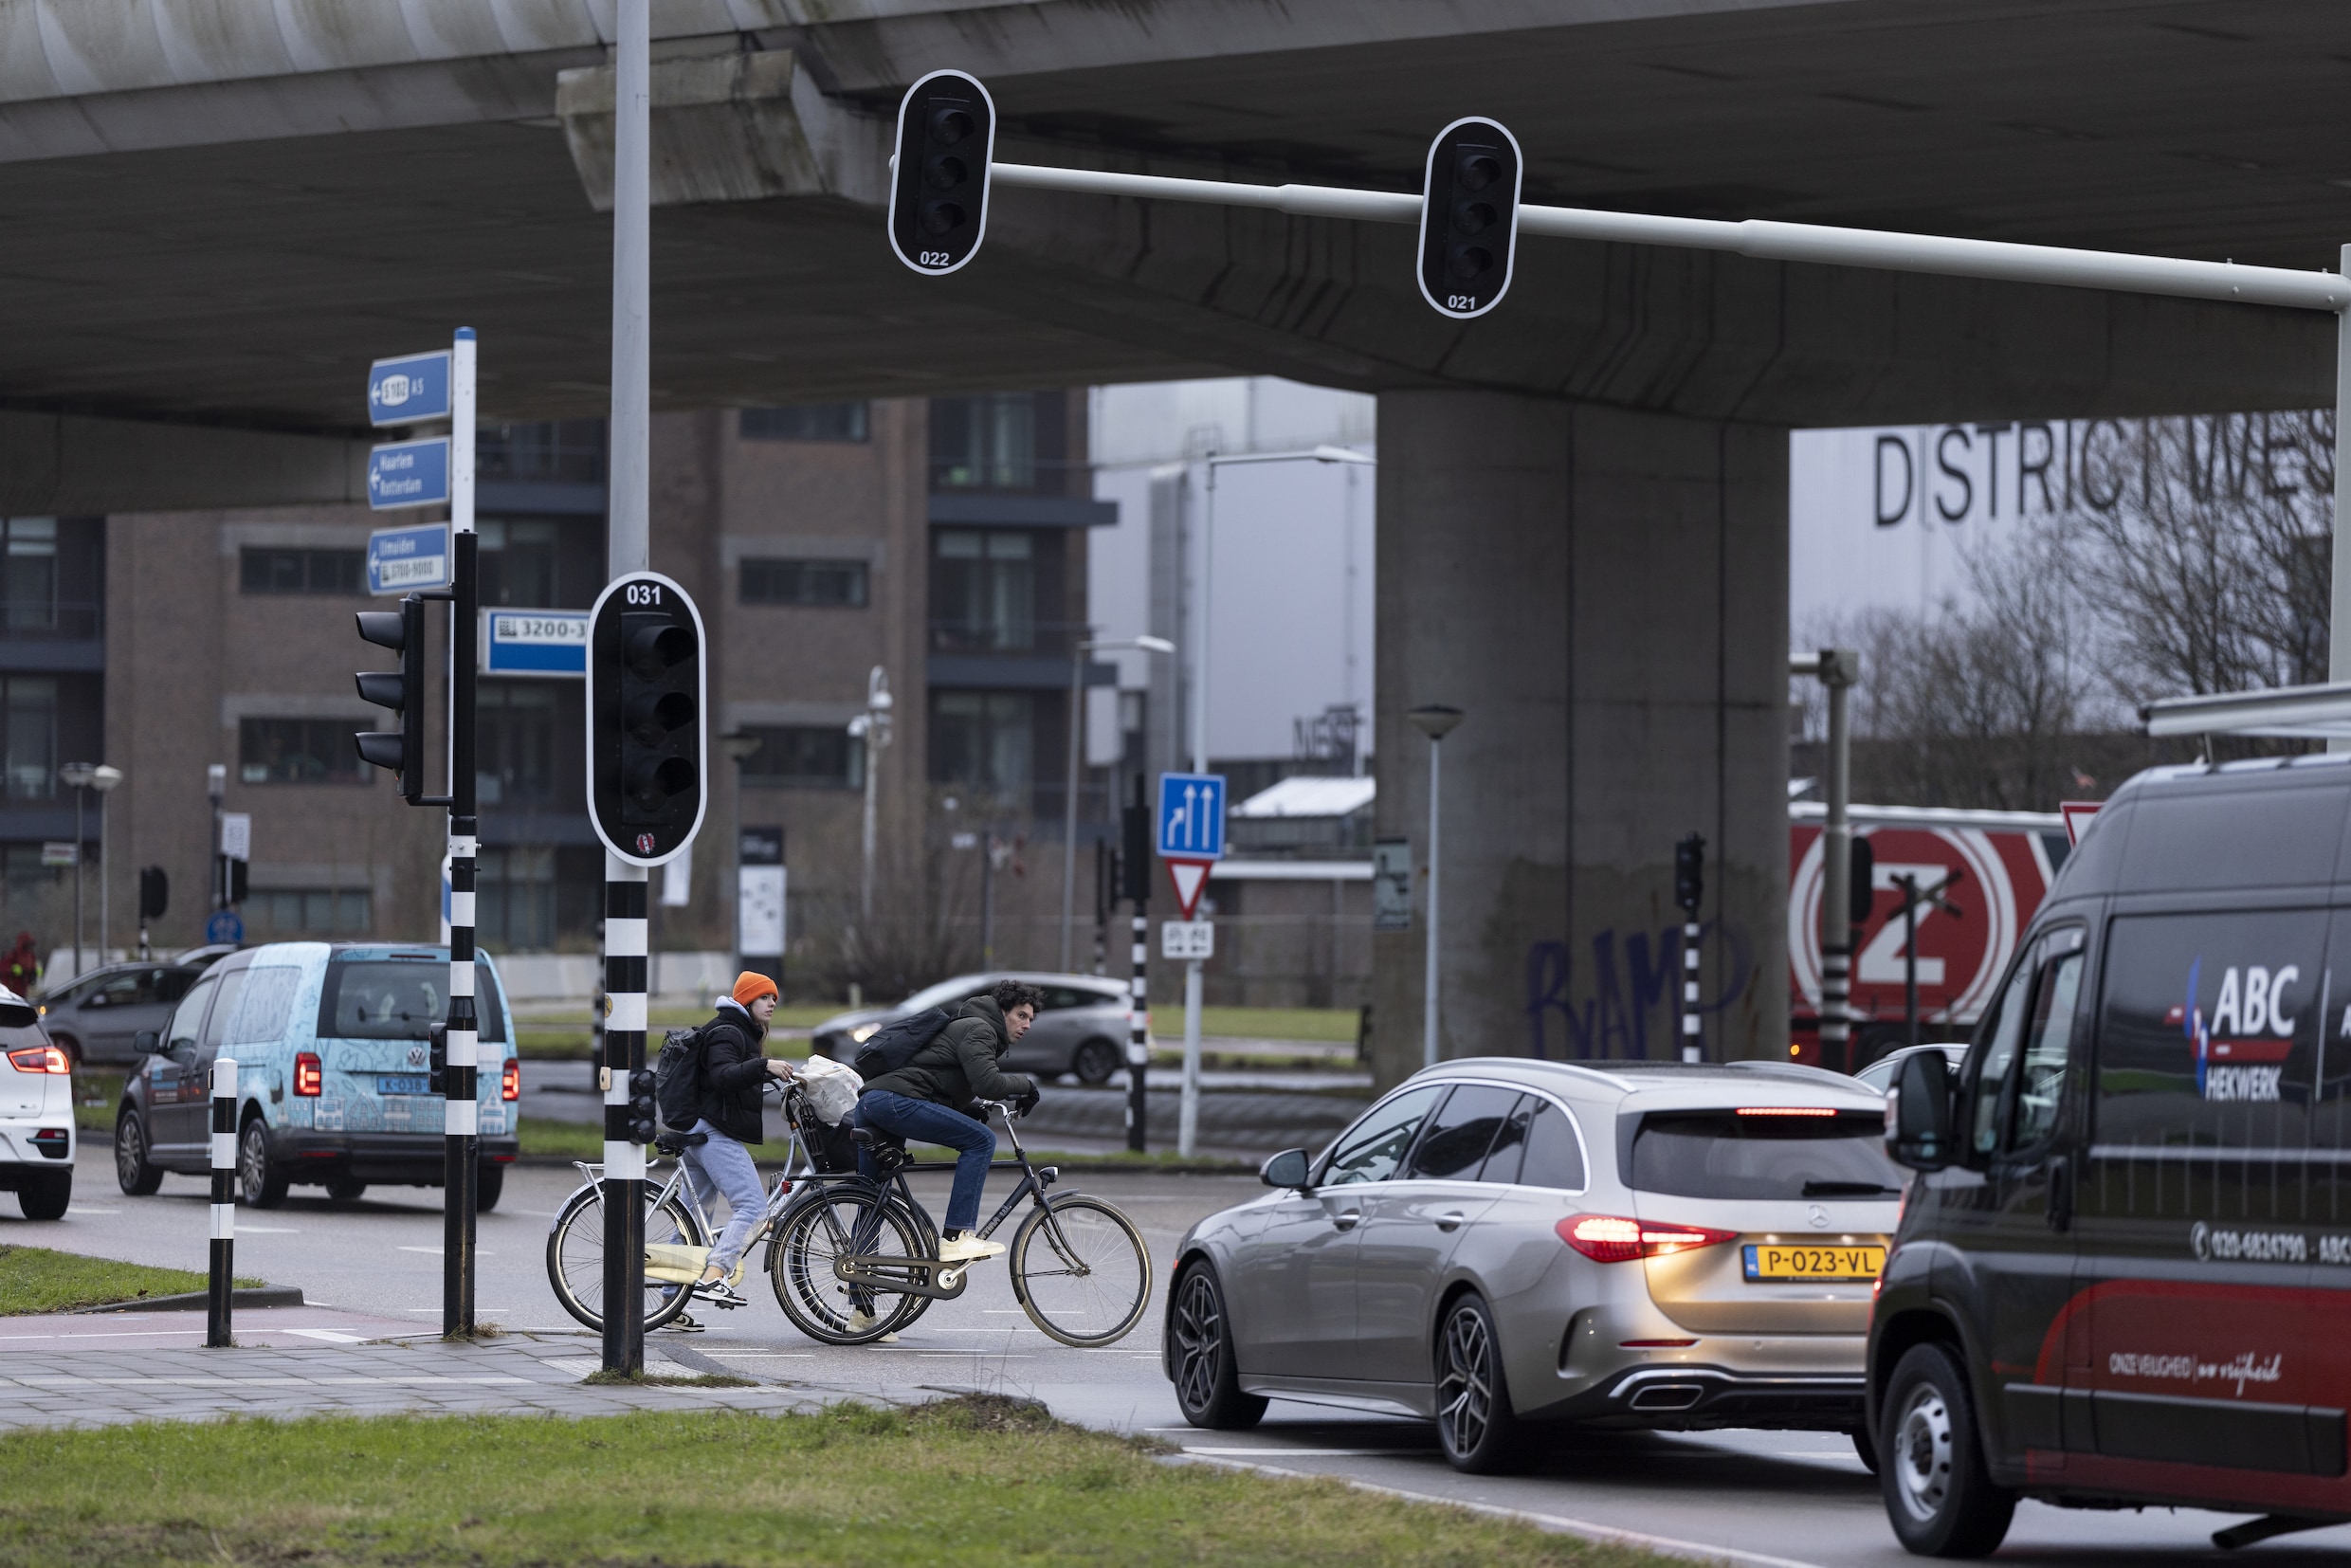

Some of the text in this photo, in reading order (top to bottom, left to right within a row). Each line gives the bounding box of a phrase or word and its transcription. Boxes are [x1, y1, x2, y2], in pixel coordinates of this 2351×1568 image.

[920, 250, 950, 266] 022
[1448, 294, 1476, 310] 021
[379, 453, 414, 471] Haarlem
[380, 477, 423, 496] Rotterdam
[627, 584, 661, 605] 031
[2211, 964, 2300, 1037] ABC
[2205, 1066, 2282, 1102] HEKWERK
[1768, 1249, 1876, 1273] P-023-VL
